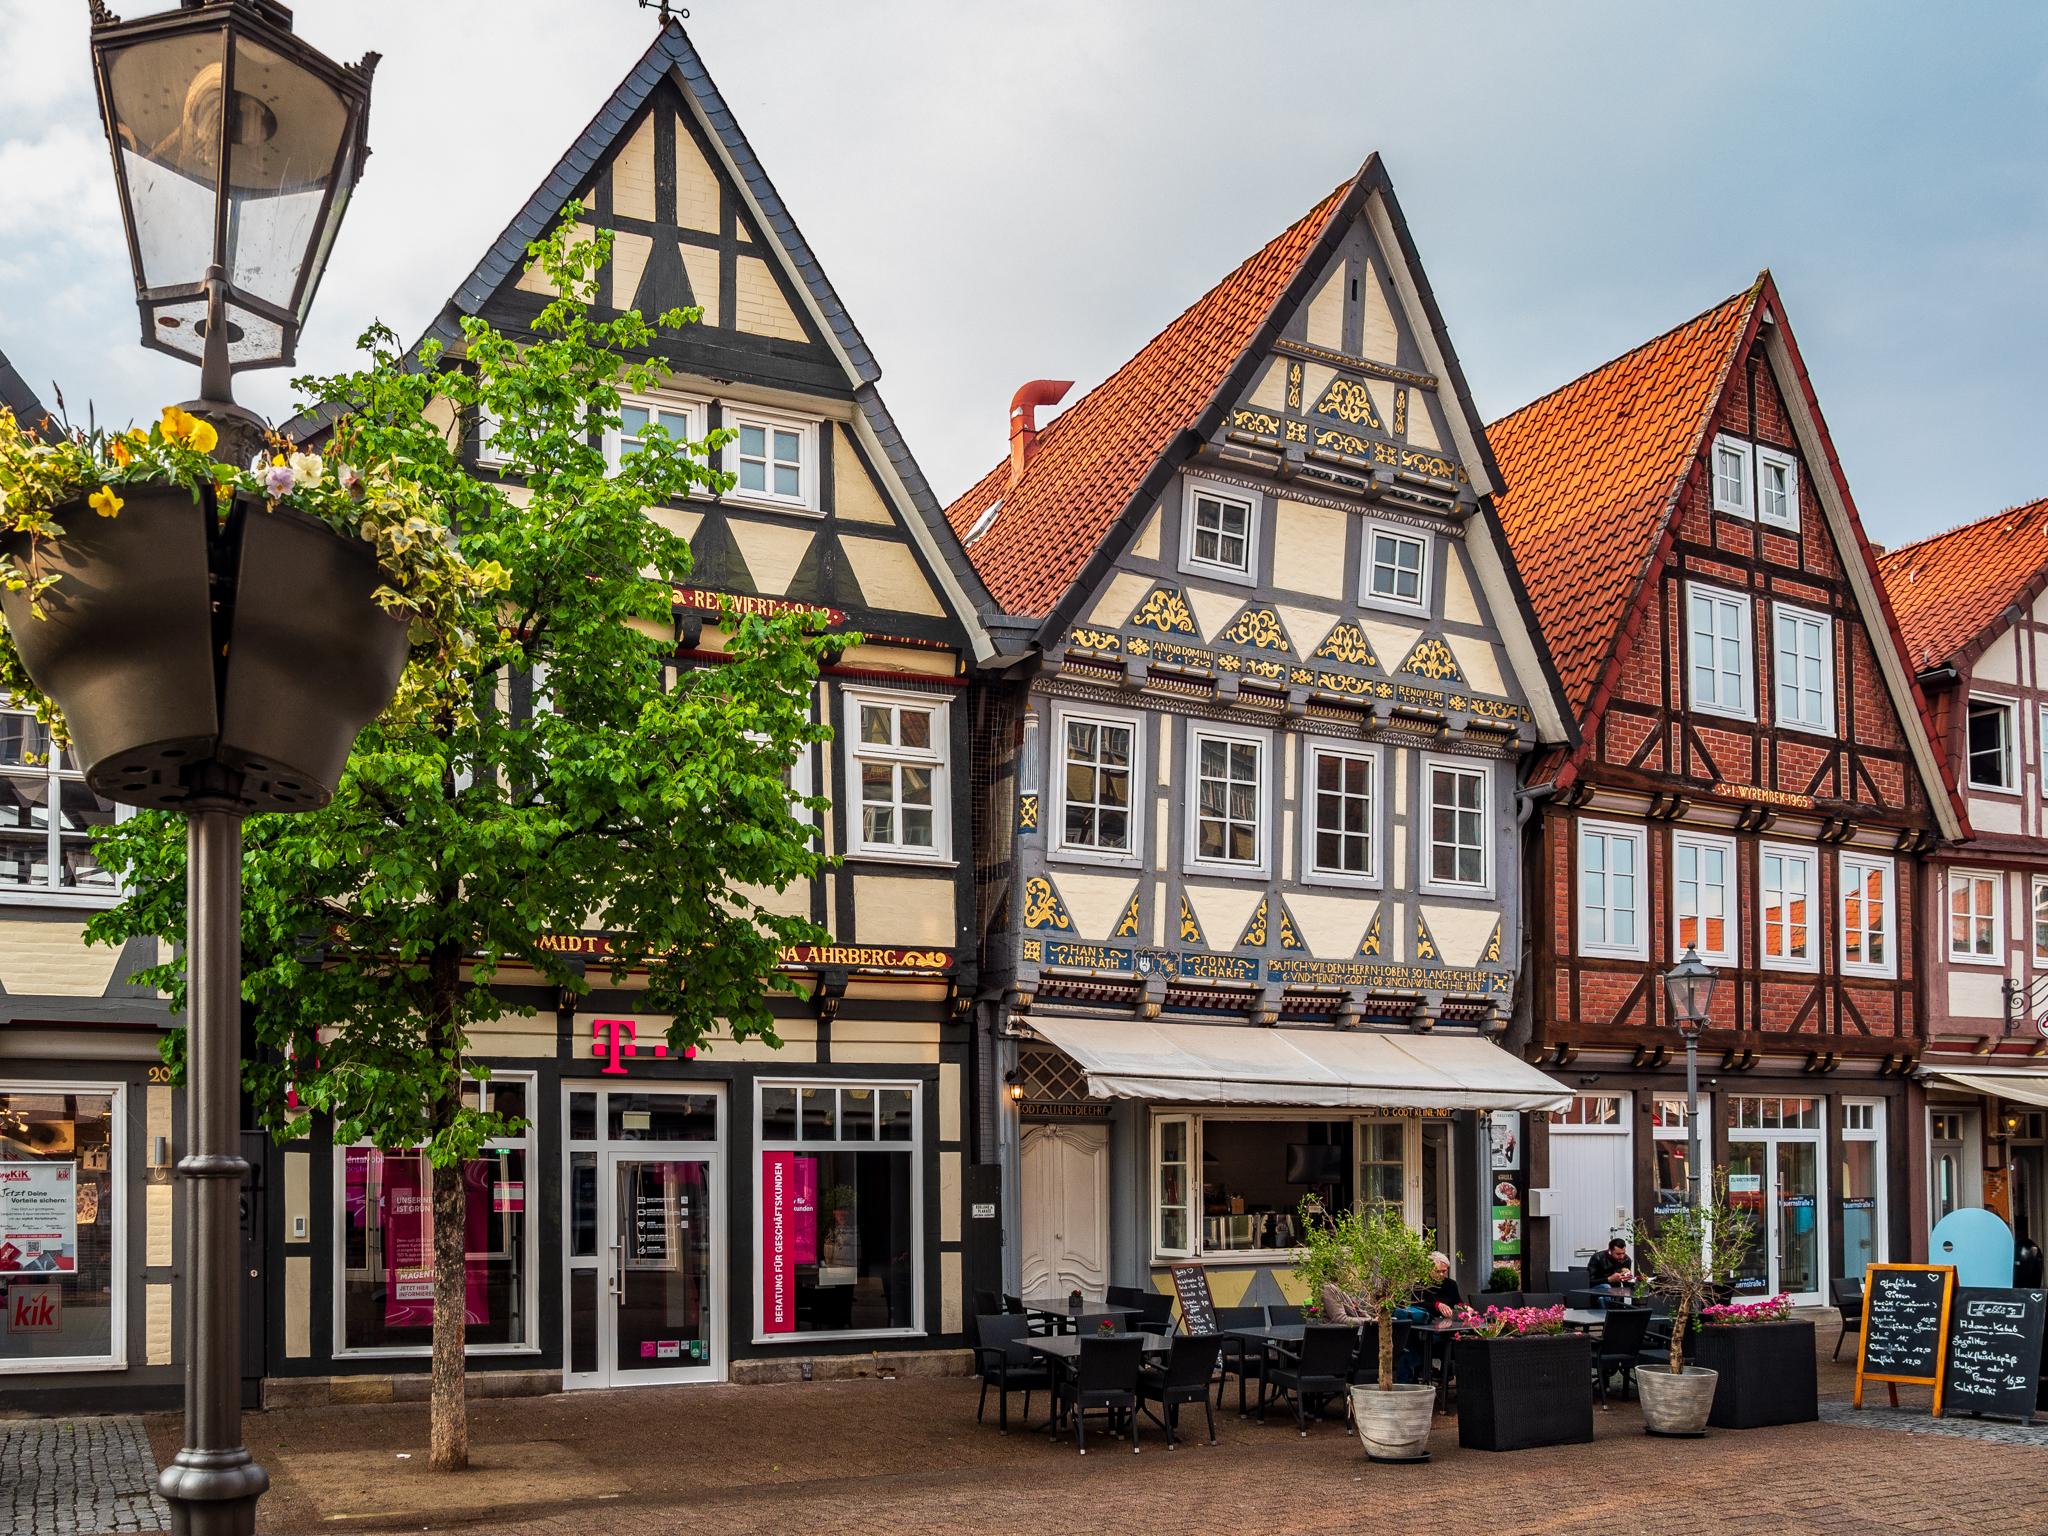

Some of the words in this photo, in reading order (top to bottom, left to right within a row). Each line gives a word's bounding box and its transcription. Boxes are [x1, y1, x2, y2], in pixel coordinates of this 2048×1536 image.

[1153, 641, 1181, 655] ANNO
[1182, 647, 1214, 660] DOMINI
[1399, 685, 1444, 701] RENOVIERT
[805, 946, 897, 966] AHRBERG
[1070, 944, 1104, 957] HANS
[1058, 955, 1119, 970] KAMPRATH
[1201, 955, 1236, 968] TONY
[1347, 964, 1378, 976] HERRN
[1381, 966, 1409, 977] LOBEN
[148, 1066, 172, 1082] 20
[773, 1162, 783, 1254] GESCHÄFTSKUNDEN
[773, 1255, 784, 1273] FÜR
[400, 1270, 434, 1280] MAGENT
[774, 1274, 784, 1323] BERATUNG
[15, 1295, 55, 1326] kik
